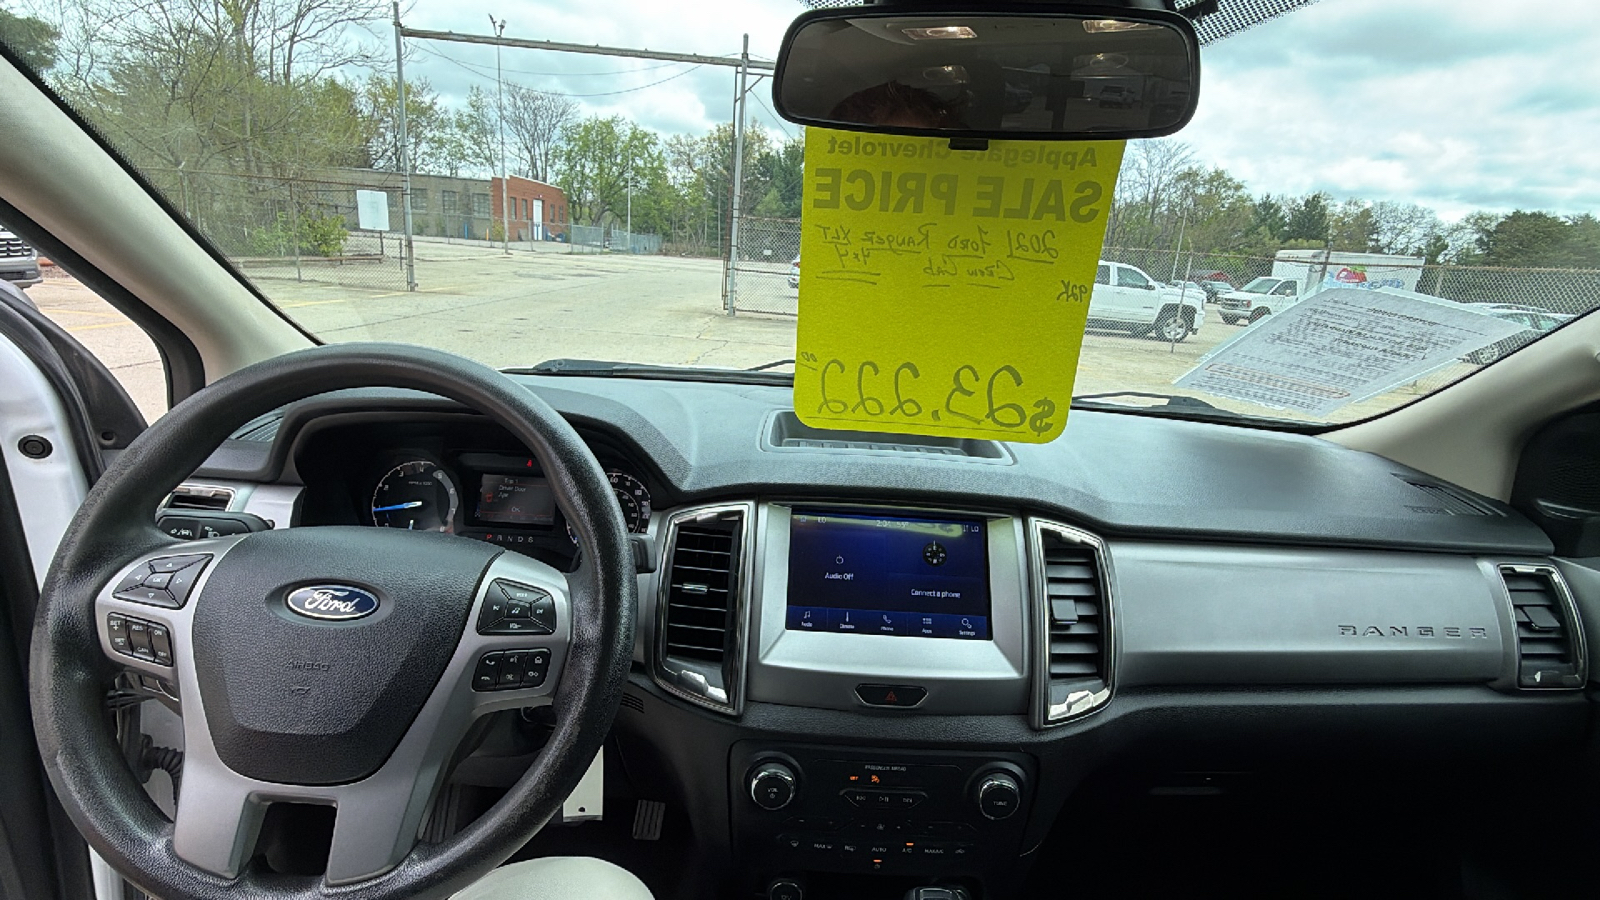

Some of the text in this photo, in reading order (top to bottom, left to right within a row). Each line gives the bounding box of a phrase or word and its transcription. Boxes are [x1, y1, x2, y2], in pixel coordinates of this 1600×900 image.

[825, 572, 854, 580] Audio Off
[911, 589, 936, 597] Connect
[941, 591, 961, 599] phone
[305, 589, 360, 612] Ford
[1338, 625, 1488, 638] RANGER
